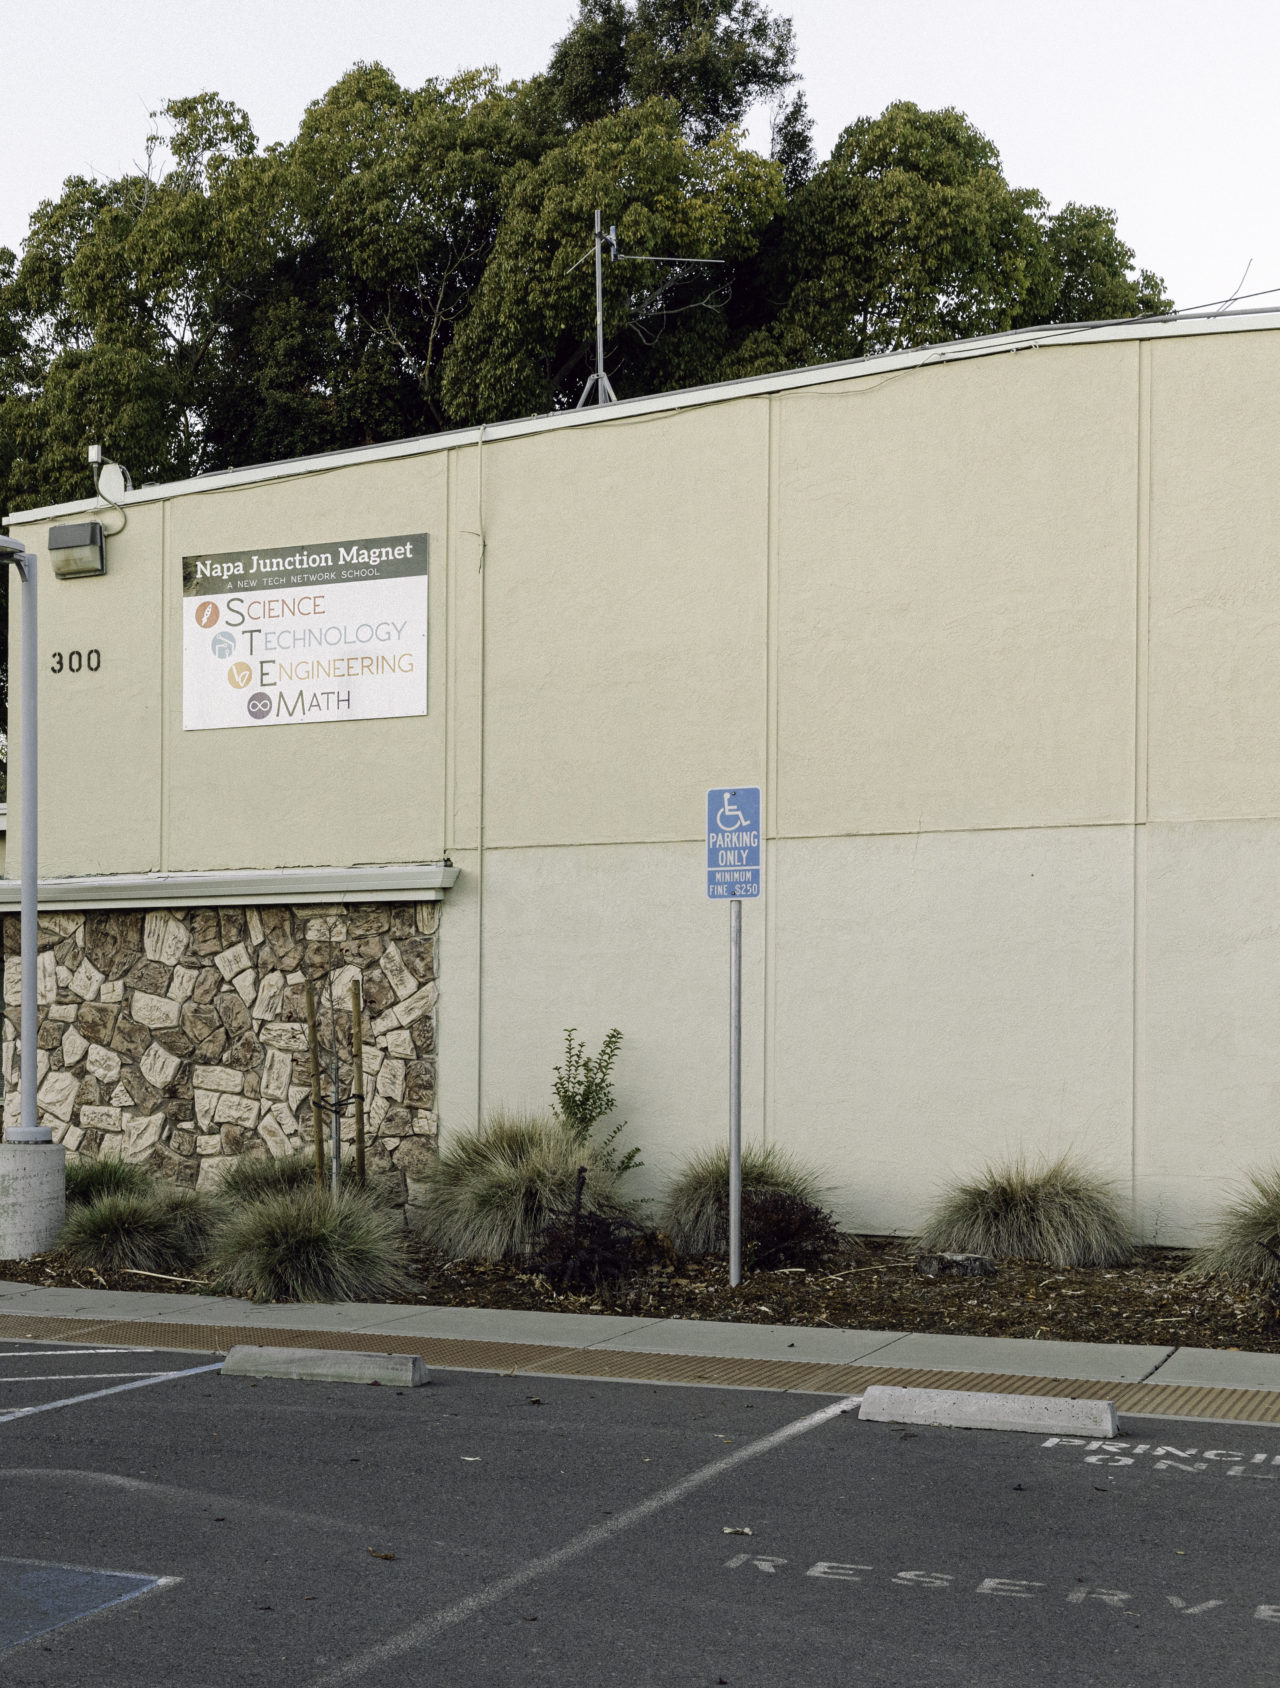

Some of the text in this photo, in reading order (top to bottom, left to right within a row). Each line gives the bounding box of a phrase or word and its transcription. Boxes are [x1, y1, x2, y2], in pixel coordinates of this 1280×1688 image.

[195, 541, 414, 579] Napa Junction Magnet
[226, 568, 381, 589] A NEW TECH NETWORK SCHOOL
[225, 596, 326, 627] SCIENCE
[241, 621, 407, 656] TECHNOLOGY
[50, 649, 101, 674] 300
[259, 653, 414, 687] ENGINEERING
[276, 690, 351, 717] MATH
[709, 831, 758, 849] PARKING
[718, 850, 749, 866] ONLY
[709, 883, 758, 896] FINE $250
[715, 871, 752, 883] MINIMUM
[1041, 1437, 1280, 1467] PRINCI
